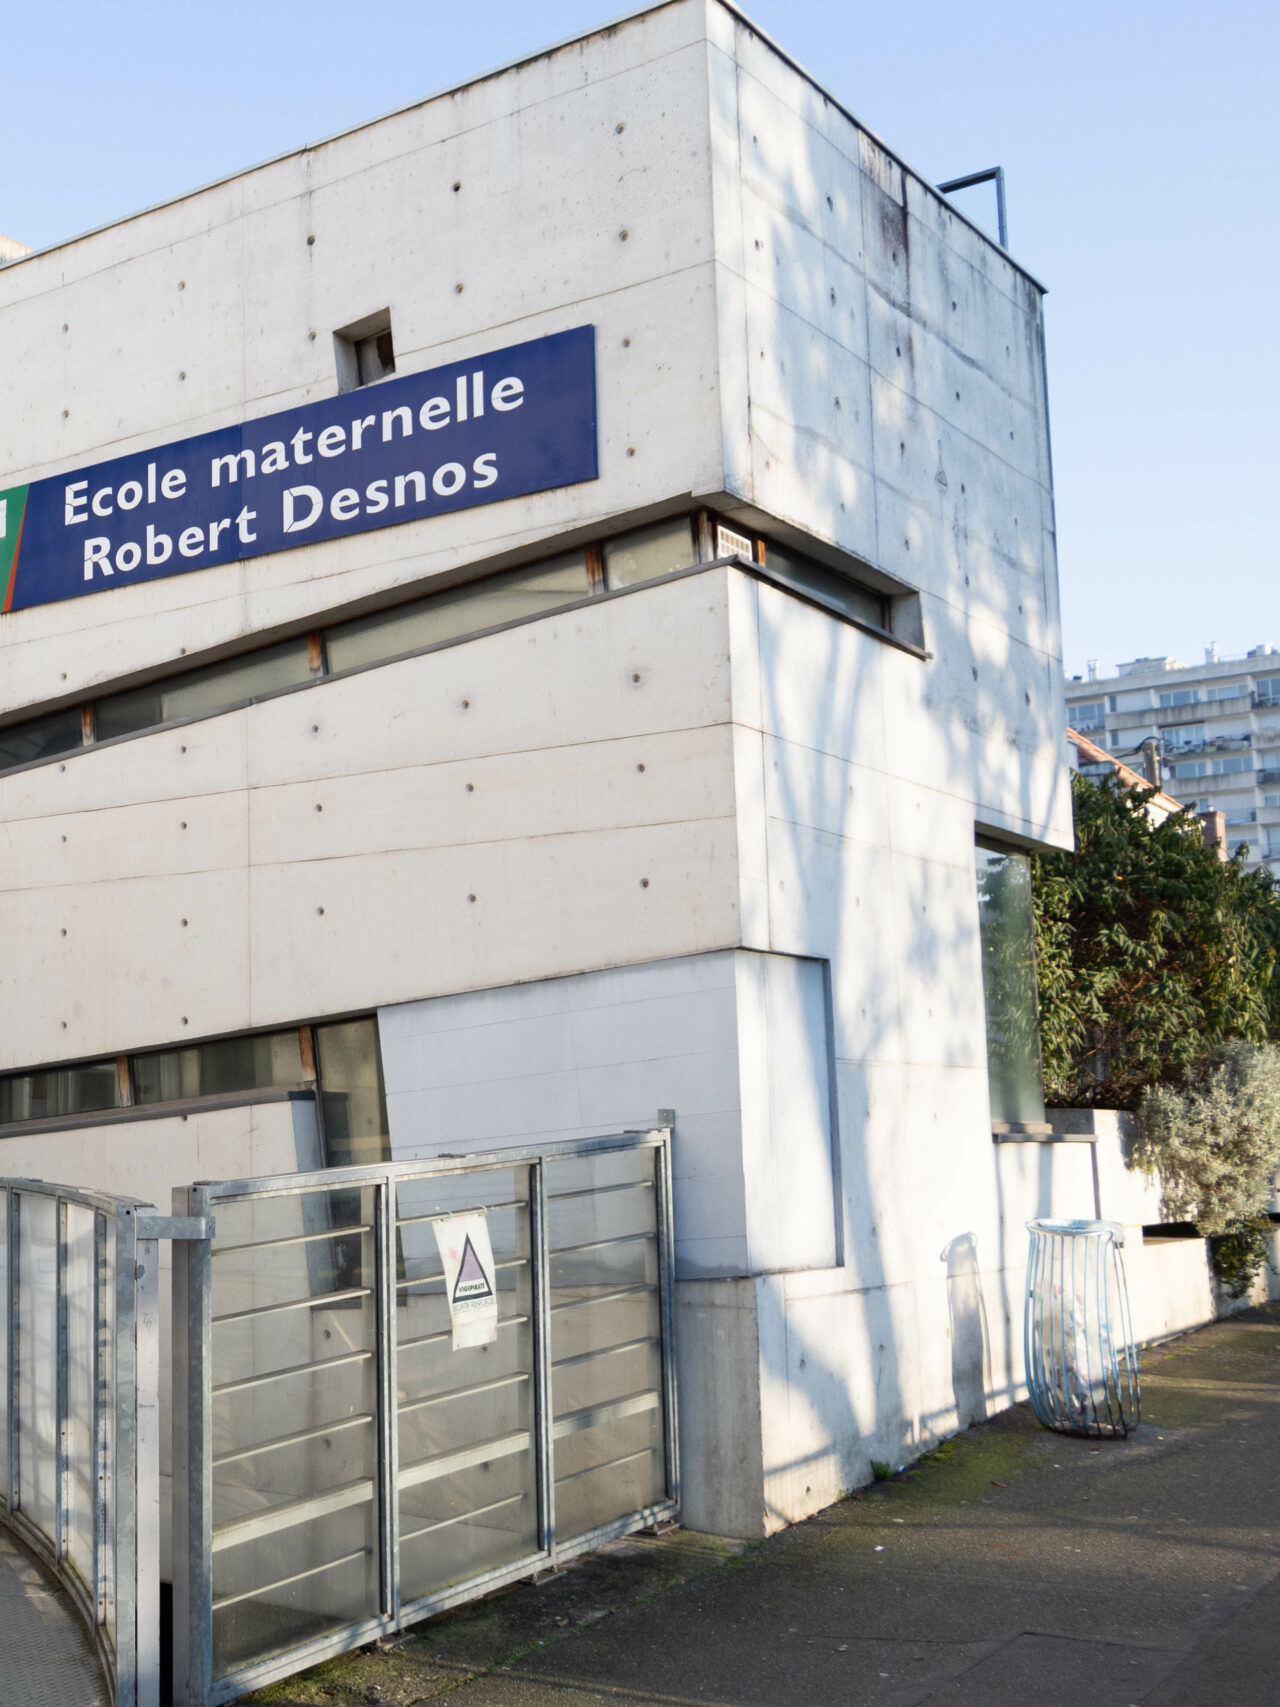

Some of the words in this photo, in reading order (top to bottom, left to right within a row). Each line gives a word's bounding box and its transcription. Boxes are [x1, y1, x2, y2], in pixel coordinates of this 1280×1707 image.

[64, 462, 188, 526] Ecole
[210, 371, 524, 487] maternelle
[83, 505, 258, 581] Robert
[282, 453, 499, 533] Desnos
